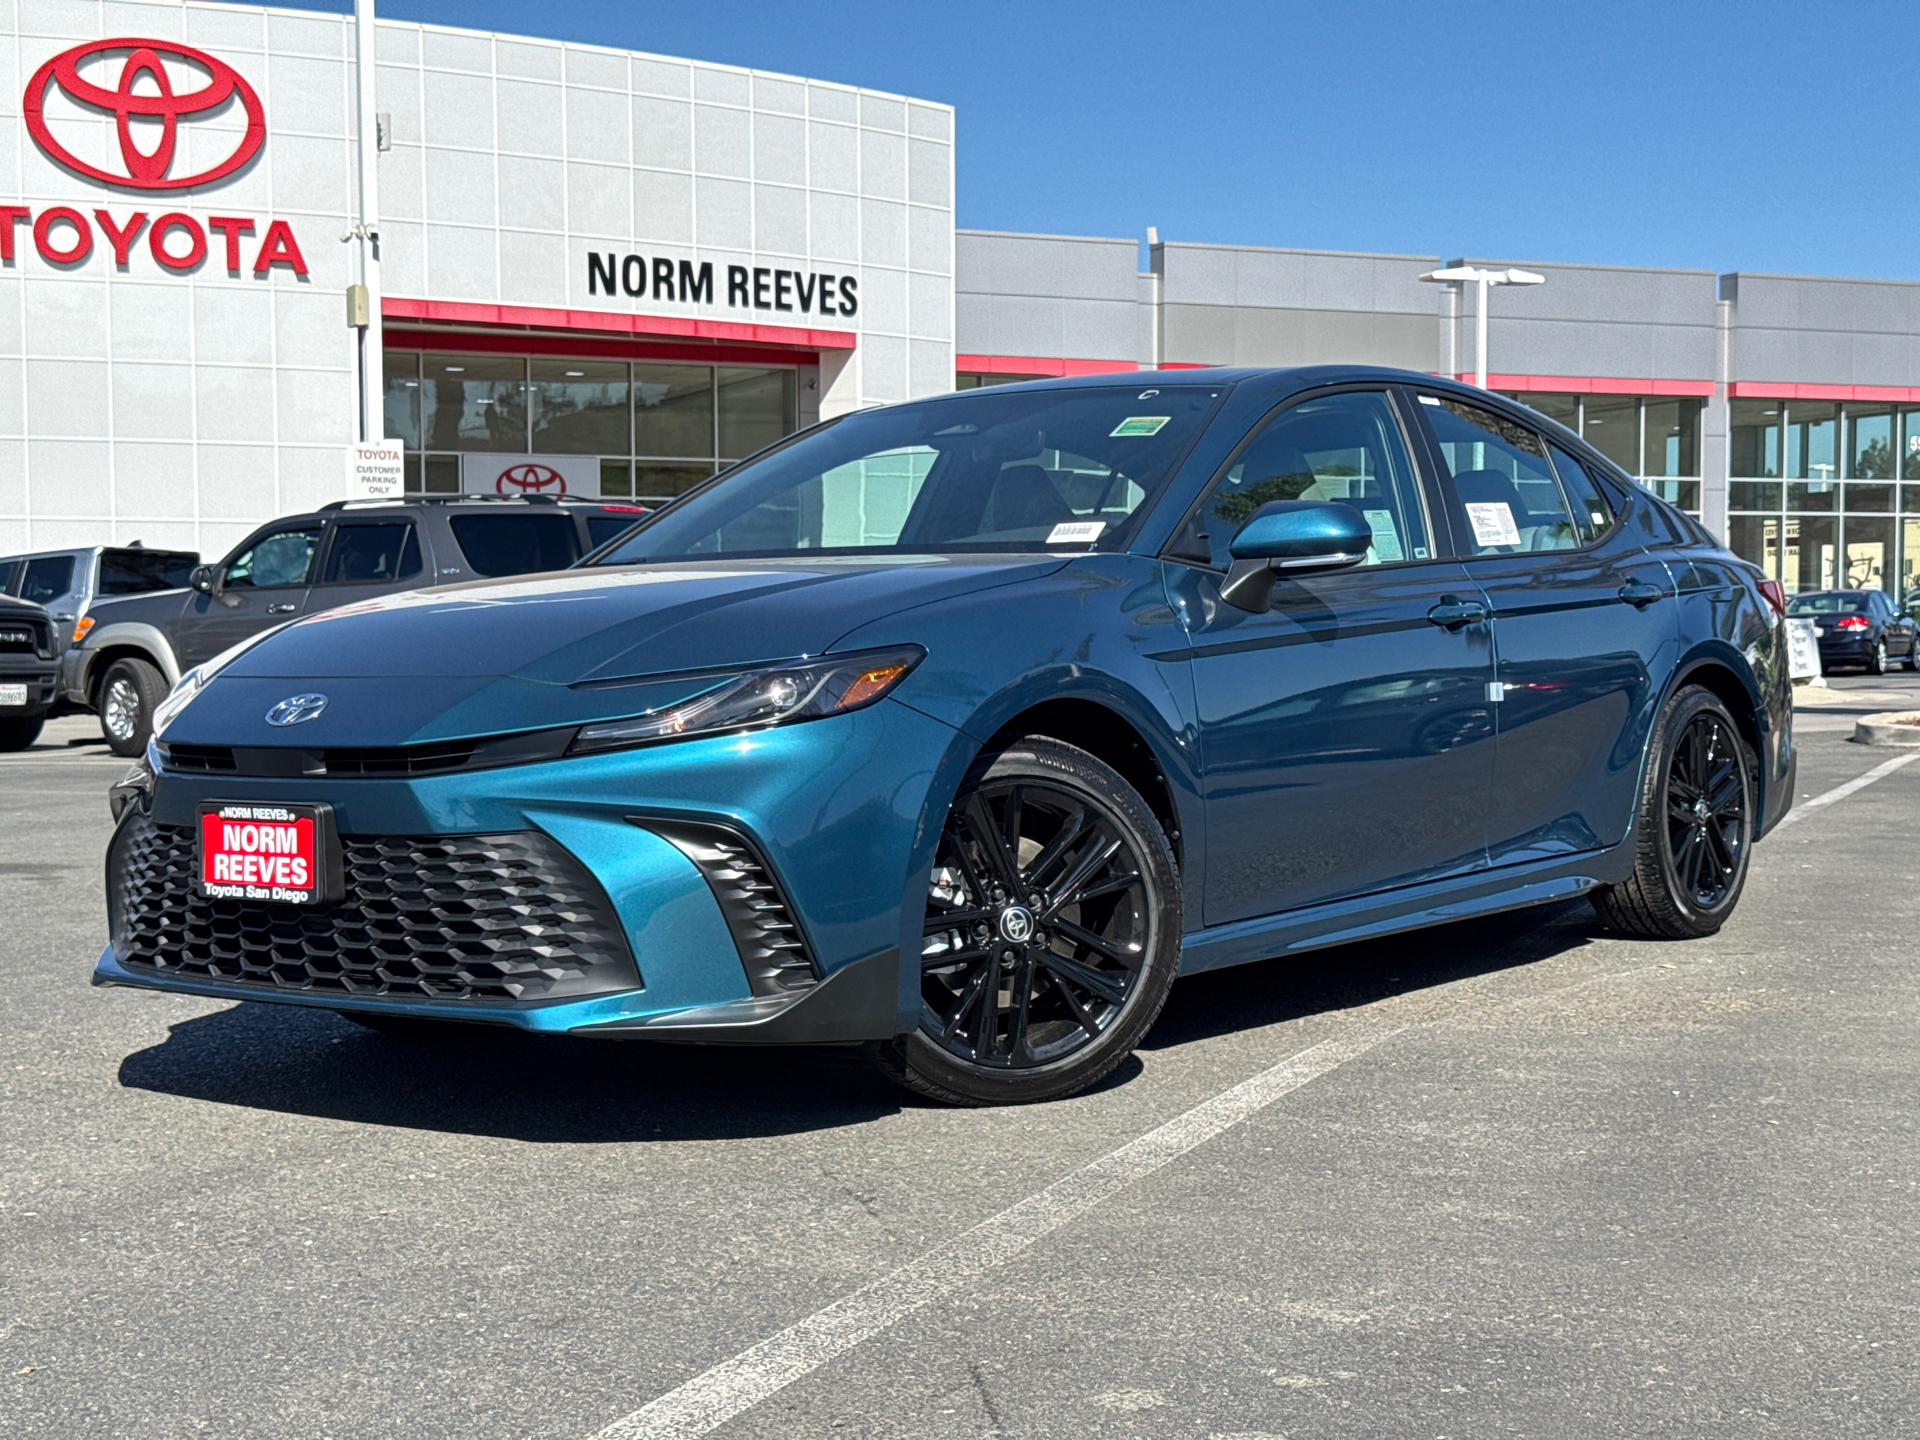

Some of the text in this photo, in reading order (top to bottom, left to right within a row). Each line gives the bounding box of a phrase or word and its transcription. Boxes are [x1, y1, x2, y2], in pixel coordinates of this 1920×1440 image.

[0, 206, 309, 275] TOYOTA
[588, 252, 858, 317] NORM REEVES
[357, 450, 400, 460] TOYOTA
[356, 465, 401, 474] CUSTOMER
[361, 476, 397, 484] PARKING
[369, 486, 390, 494] ONLY
[224, 807, 289, 820] NORM REEVES
[223, 824, 297, 854] NORM
[214, 853, 308, 885] REEVES
[204, 883, 308, 904] Toyota San Diego
